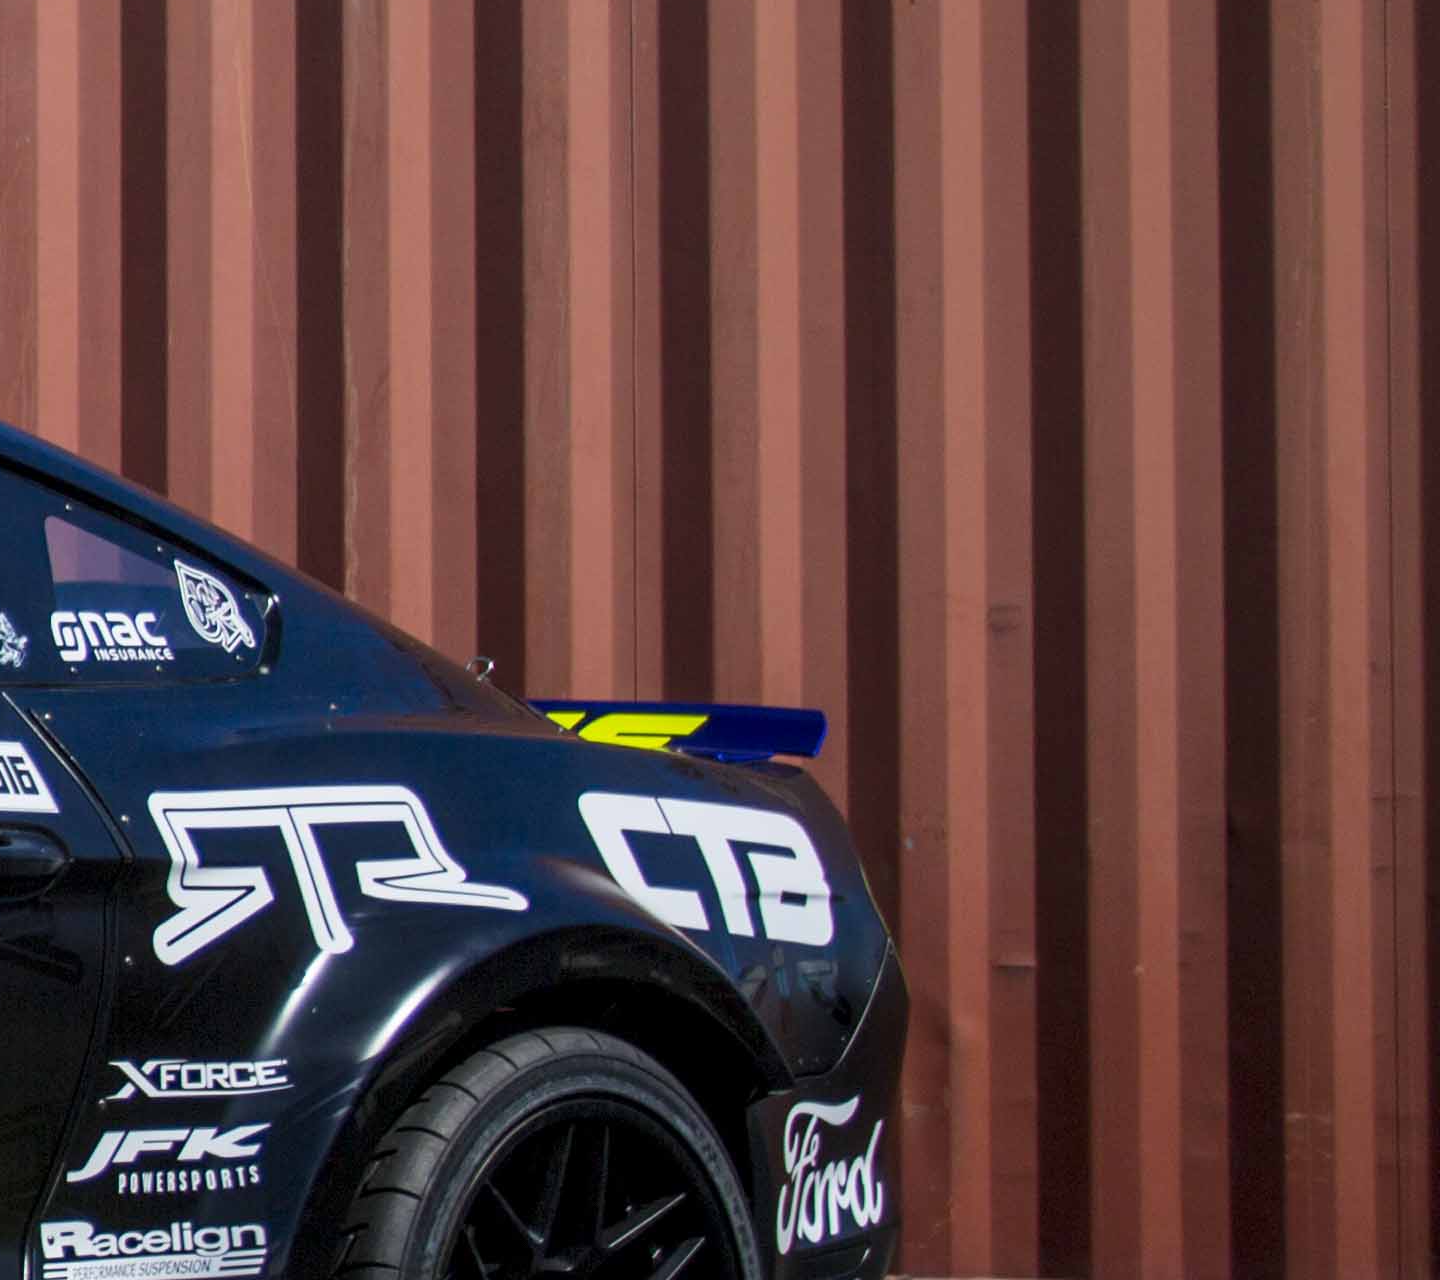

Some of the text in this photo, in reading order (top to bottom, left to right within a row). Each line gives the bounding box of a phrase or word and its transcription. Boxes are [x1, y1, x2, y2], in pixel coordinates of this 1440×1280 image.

[94, 647, 175, 662] INSURANCE
[578, 791, 834, 948] CTB
[104, 1058, 294, 1100] XFORCE
[66, 1122, 272, 1183] JFK
[117, 1165, 260, 1194] POWERSPORTS
[776, 1093, 883, 1255] Ford
[40, 1220, 268, 1260] Racelign
[138, 1258, 212, 1277] SUSPENSION
